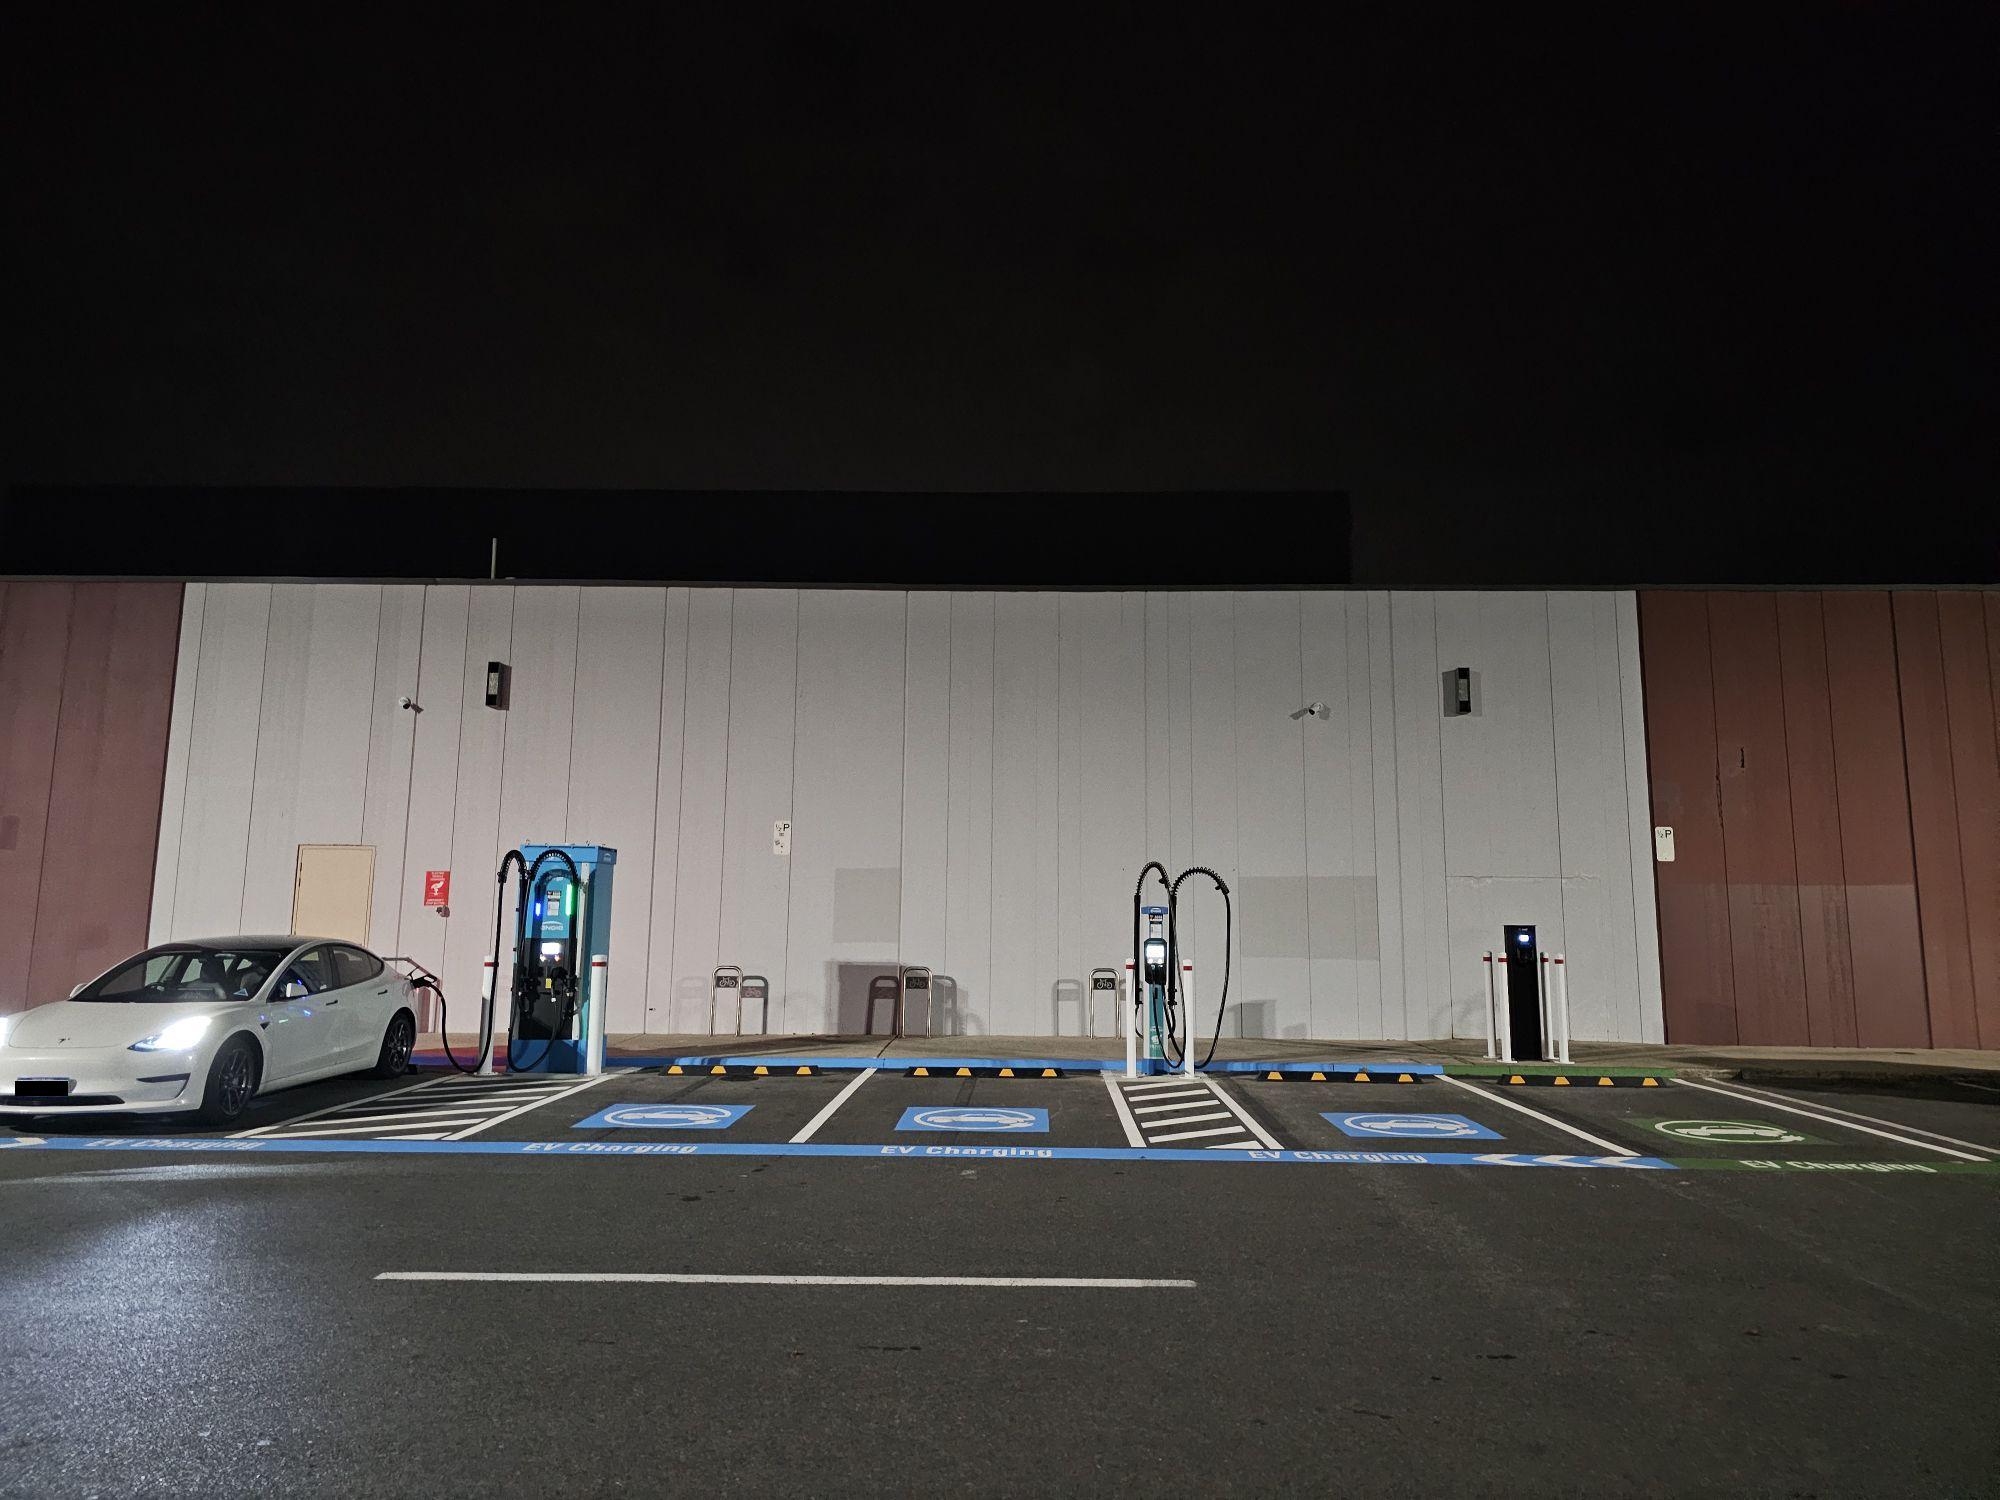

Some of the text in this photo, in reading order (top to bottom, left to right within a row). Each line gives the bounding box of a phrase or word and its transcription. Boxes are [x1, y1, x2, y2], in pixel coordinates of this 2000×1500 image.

[523, 1143, 698, 1153] EV Charging
[880, 1146, 1053, 1157] EV Charging
[1248, 1150, 1428, 1163] EV Charging
[1738, 1159, 1938, 1173] EV Charging
